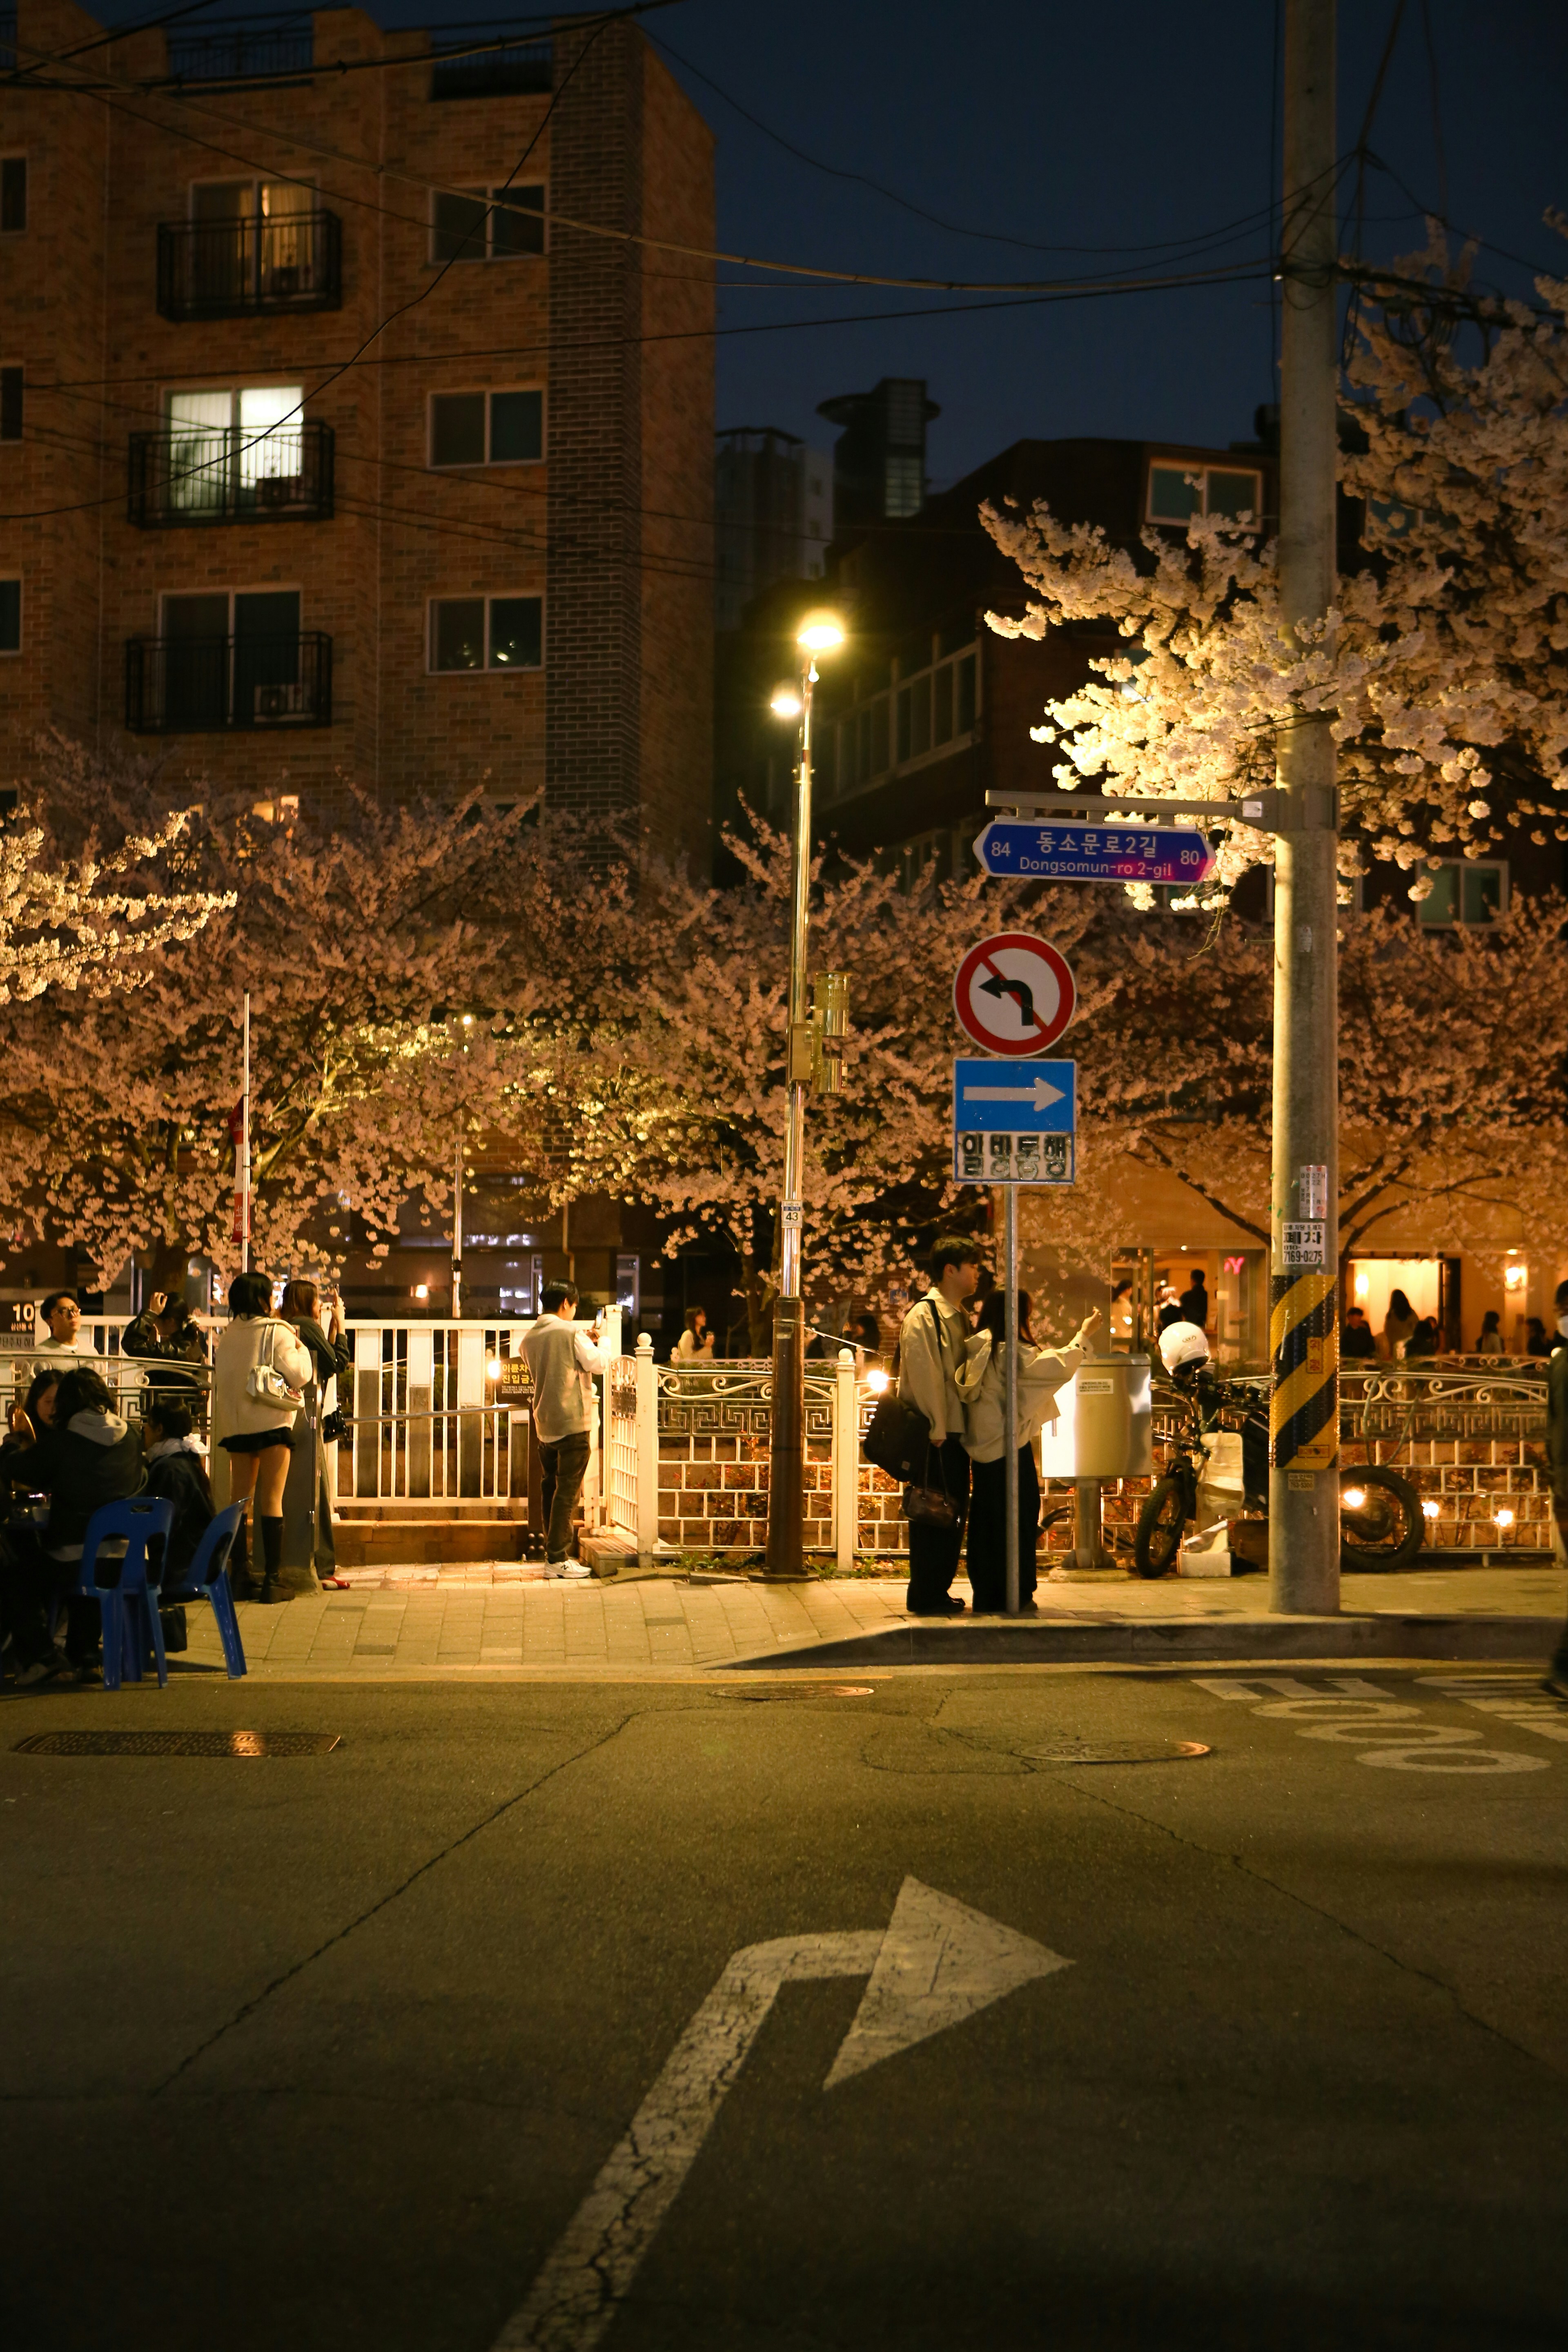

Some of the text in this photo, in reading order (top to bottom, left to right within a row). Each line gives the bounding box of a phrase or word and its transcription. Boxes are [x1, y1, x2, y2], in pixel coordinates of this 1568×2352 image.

[991, 842, 1011, 857] 84
[1036, 831, 1156, 858] 동소문로2길
[1180, 850, 1199, 865] 80
[1020, 857, 1171, 878] Dongsomun-ro 2-gil
[962, 1133, 1066, 1180] 일방통행
[786, 1212, 798, 1221] 43
[1283, 1250, 1322, 1263] 7169-0275
[502, 1363, 528, 1373] 이륜차
[502, 1374, 533, 1384] 진입금
